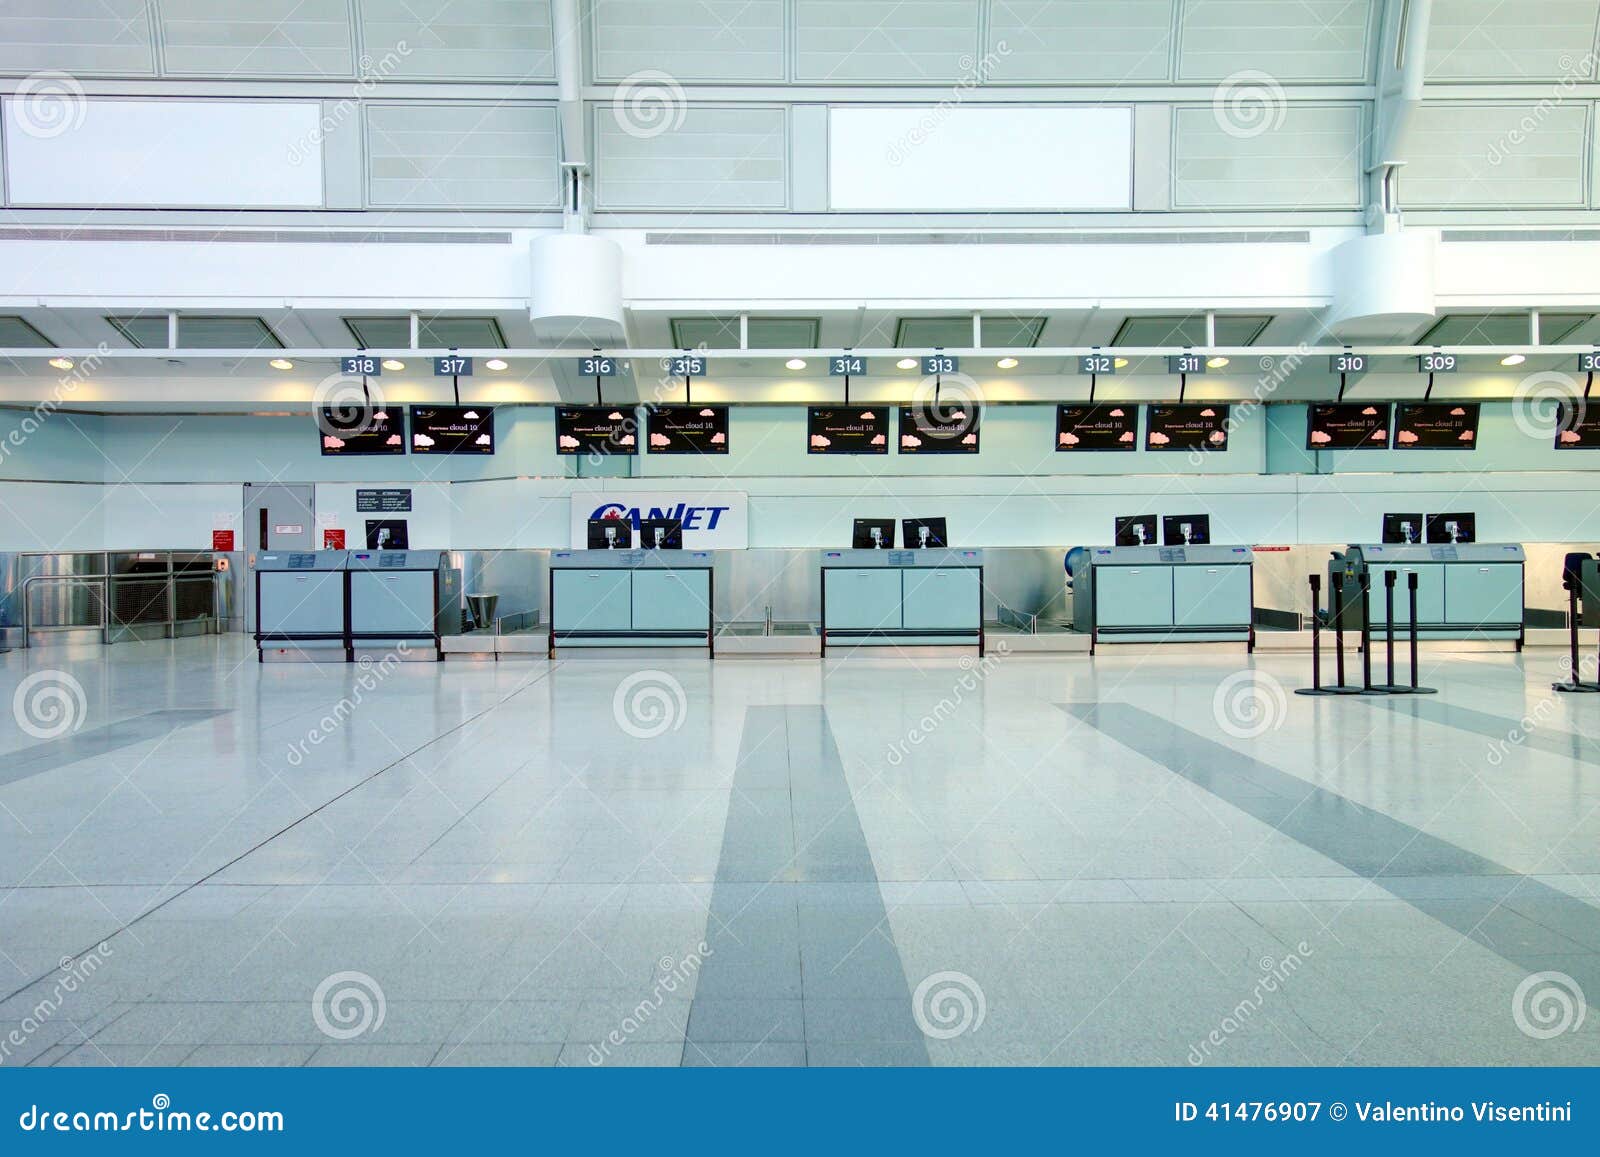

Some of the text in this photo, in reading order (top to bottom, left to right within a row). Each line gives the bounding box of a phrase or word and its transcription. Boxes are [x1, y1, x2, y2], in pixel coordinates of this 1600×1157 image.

[347, 359, 374, 373] 318
[440, 359, 465, 373] 317
[584, 359, 611, 373] 316
[675, 359, 701, 373] 315
[835, 359, 861, 373] 314
[928, 358, 953, 372] 313
[1085, 358, 1110, 371] 312
[1178, 358, 1198, 371] 311
[1337, 357, 1363, 370] 310
[1424, 356, 1455, 370] 309
[1584, 355, 1600, 369] 30
